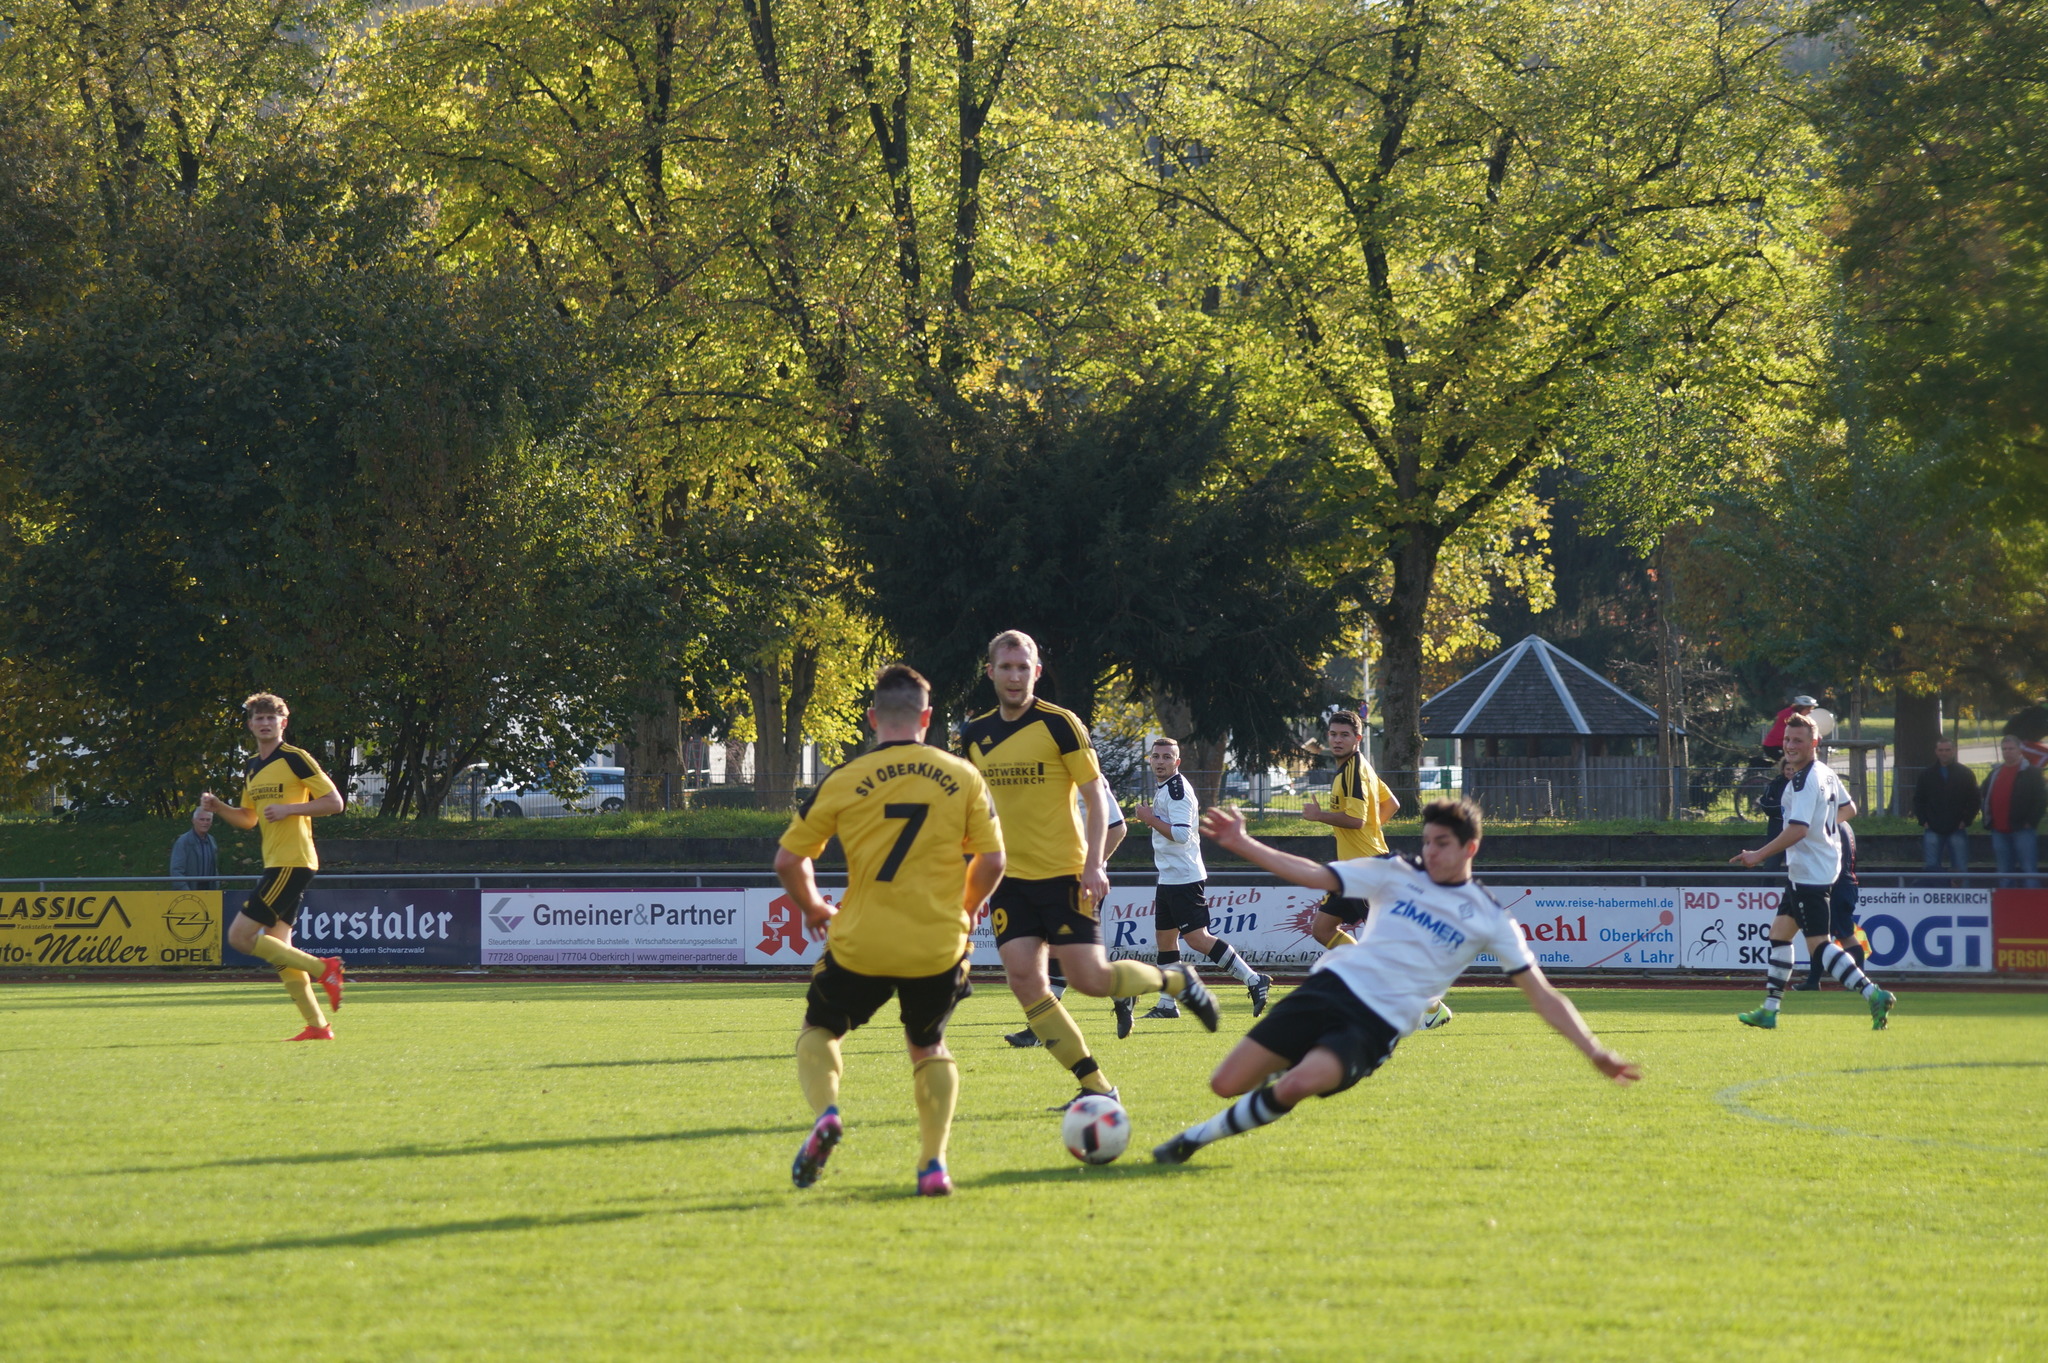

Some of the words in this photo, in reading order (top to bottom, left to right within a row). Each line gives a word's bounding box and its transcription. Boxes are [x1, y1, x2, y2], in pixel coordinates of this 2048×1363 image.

[856, 776, 875, 796] SV
[876, 762, 959, 796] OBERKIRCH
[981, 767, 1036, 778] ADTWERKE
[990, 776, 1045, 786] OBERKIRCH
[875, 803, 930, 882] 7
[1535, 898, 1674, 908] www.reise-habermehl.de
[1737, 891, 1785, 910] SHO
[1909, 893, 1919, 904] in
[1923, 893, 1988, 905] OBERKIRCH
[291, 904, 453, 940] terstaler
[533, 903, 737, 926] Gmeiner&Partner
[488, 938, 531, 946] Steuerberater
[536, 938, 595, 946] Landwirtschaftliche
[597, 938, 630, 946] Buchstelle
[635, 937, 738, 946] Wirtschaftsberatungsgesellschaft
[1112, 920, 1147, 948] R.
[1600, 928, 1674, 943] Oberkirch
[1852, 913, 1989, 967] OGT
[160, 948, 213, 963] OPEL
[360, 946, 376, 954] dem
[378, 946, 425, 954] Schwarzwald
[488, 952, 514, 962] 77728
[516, 952, 554, 963] Oppenau
[561, 952, 587, 961] 77704
[590, 952, 630, 962] Oberkirch
[637, 952, 738, 963] www.gmeiner-partner.de
[1540, 951, 1574, 962] nahe.
[1641, 950, 1675, 963] Lahr
[1998, 949, 2048, 968] PERSO
